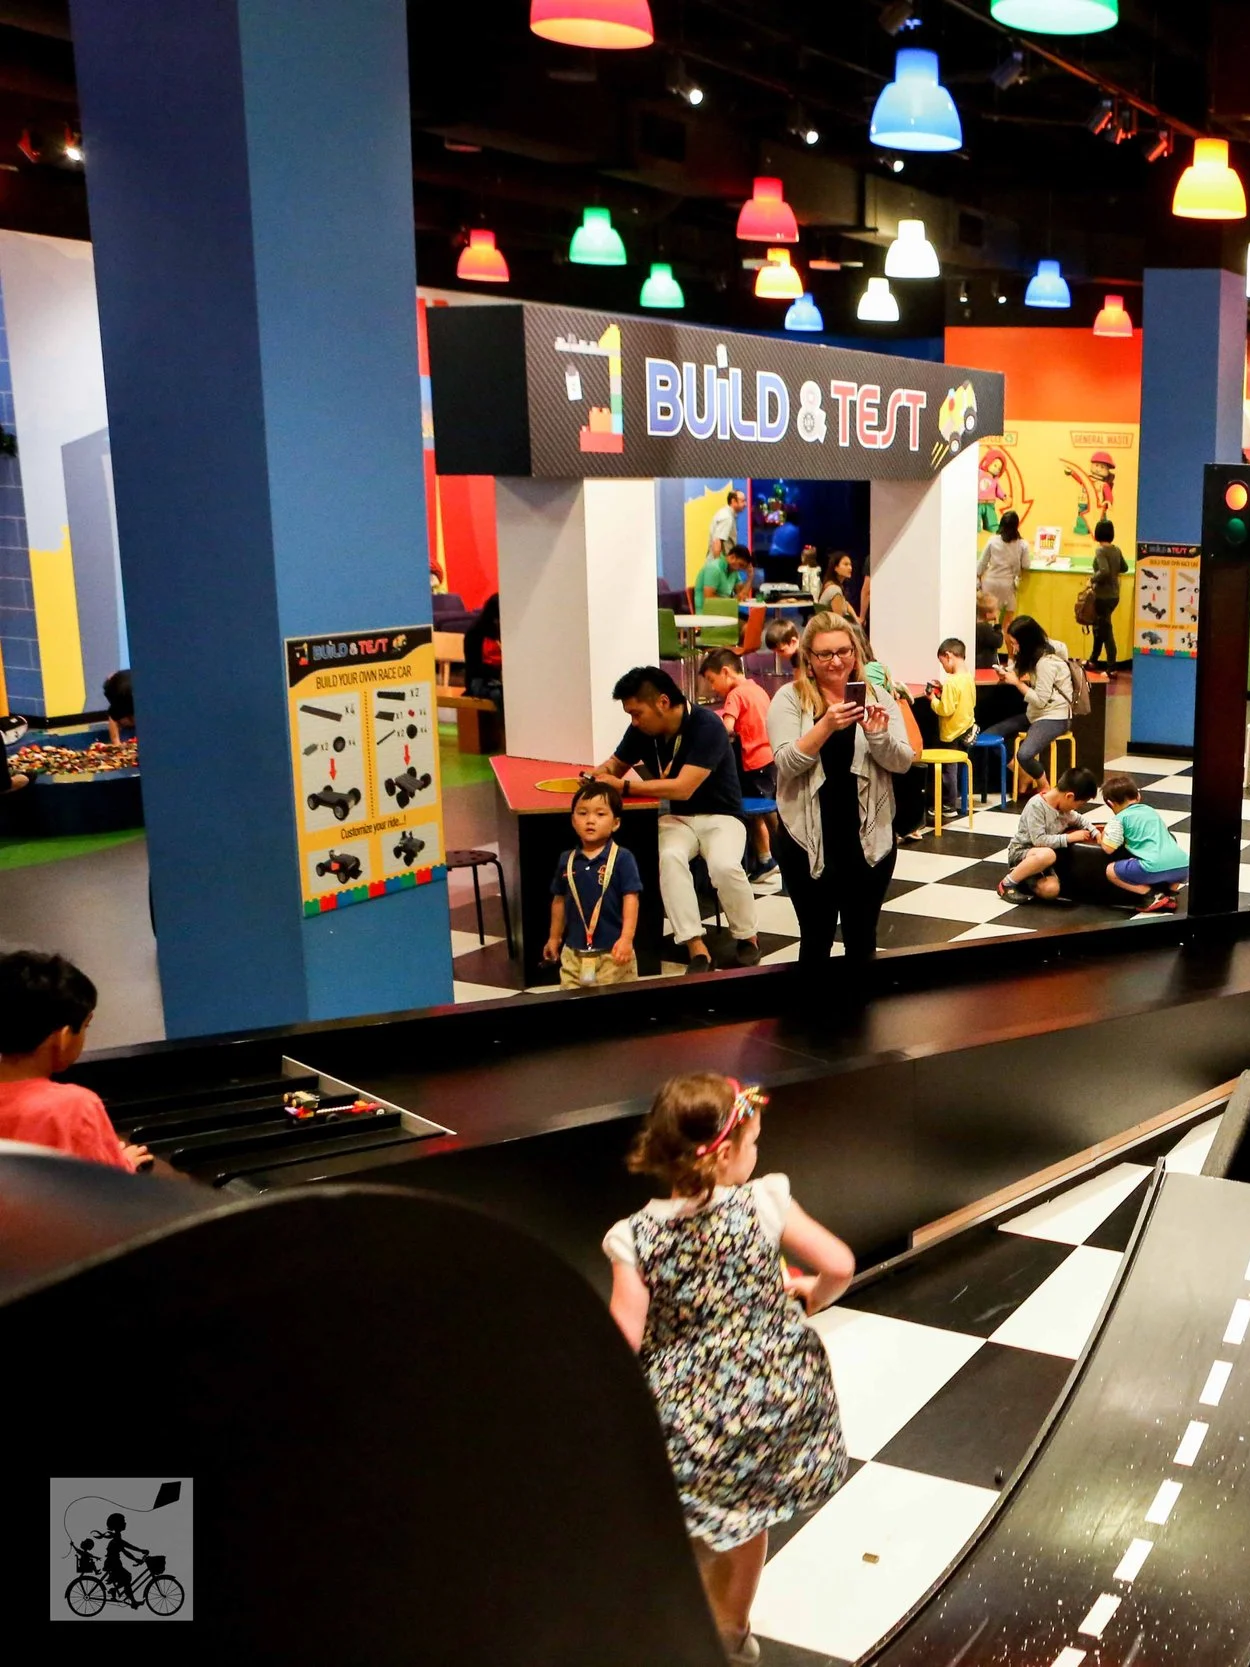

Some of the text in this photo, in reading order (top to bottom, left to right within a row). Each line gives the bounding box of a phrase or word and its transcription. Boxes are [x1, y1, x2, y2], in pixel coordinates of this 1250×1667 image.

[797, 380, 827, 443] &
[831, 380, 927, 451] TEST
[349, 642, 358, 655] &
[358, 638, 388, 655] TEST
[316, 665, 412, 690] BUILD YOUR OWN RACE CAR
[341, 824, 373, 840] Customize
[373, 821, 387, 834] your
